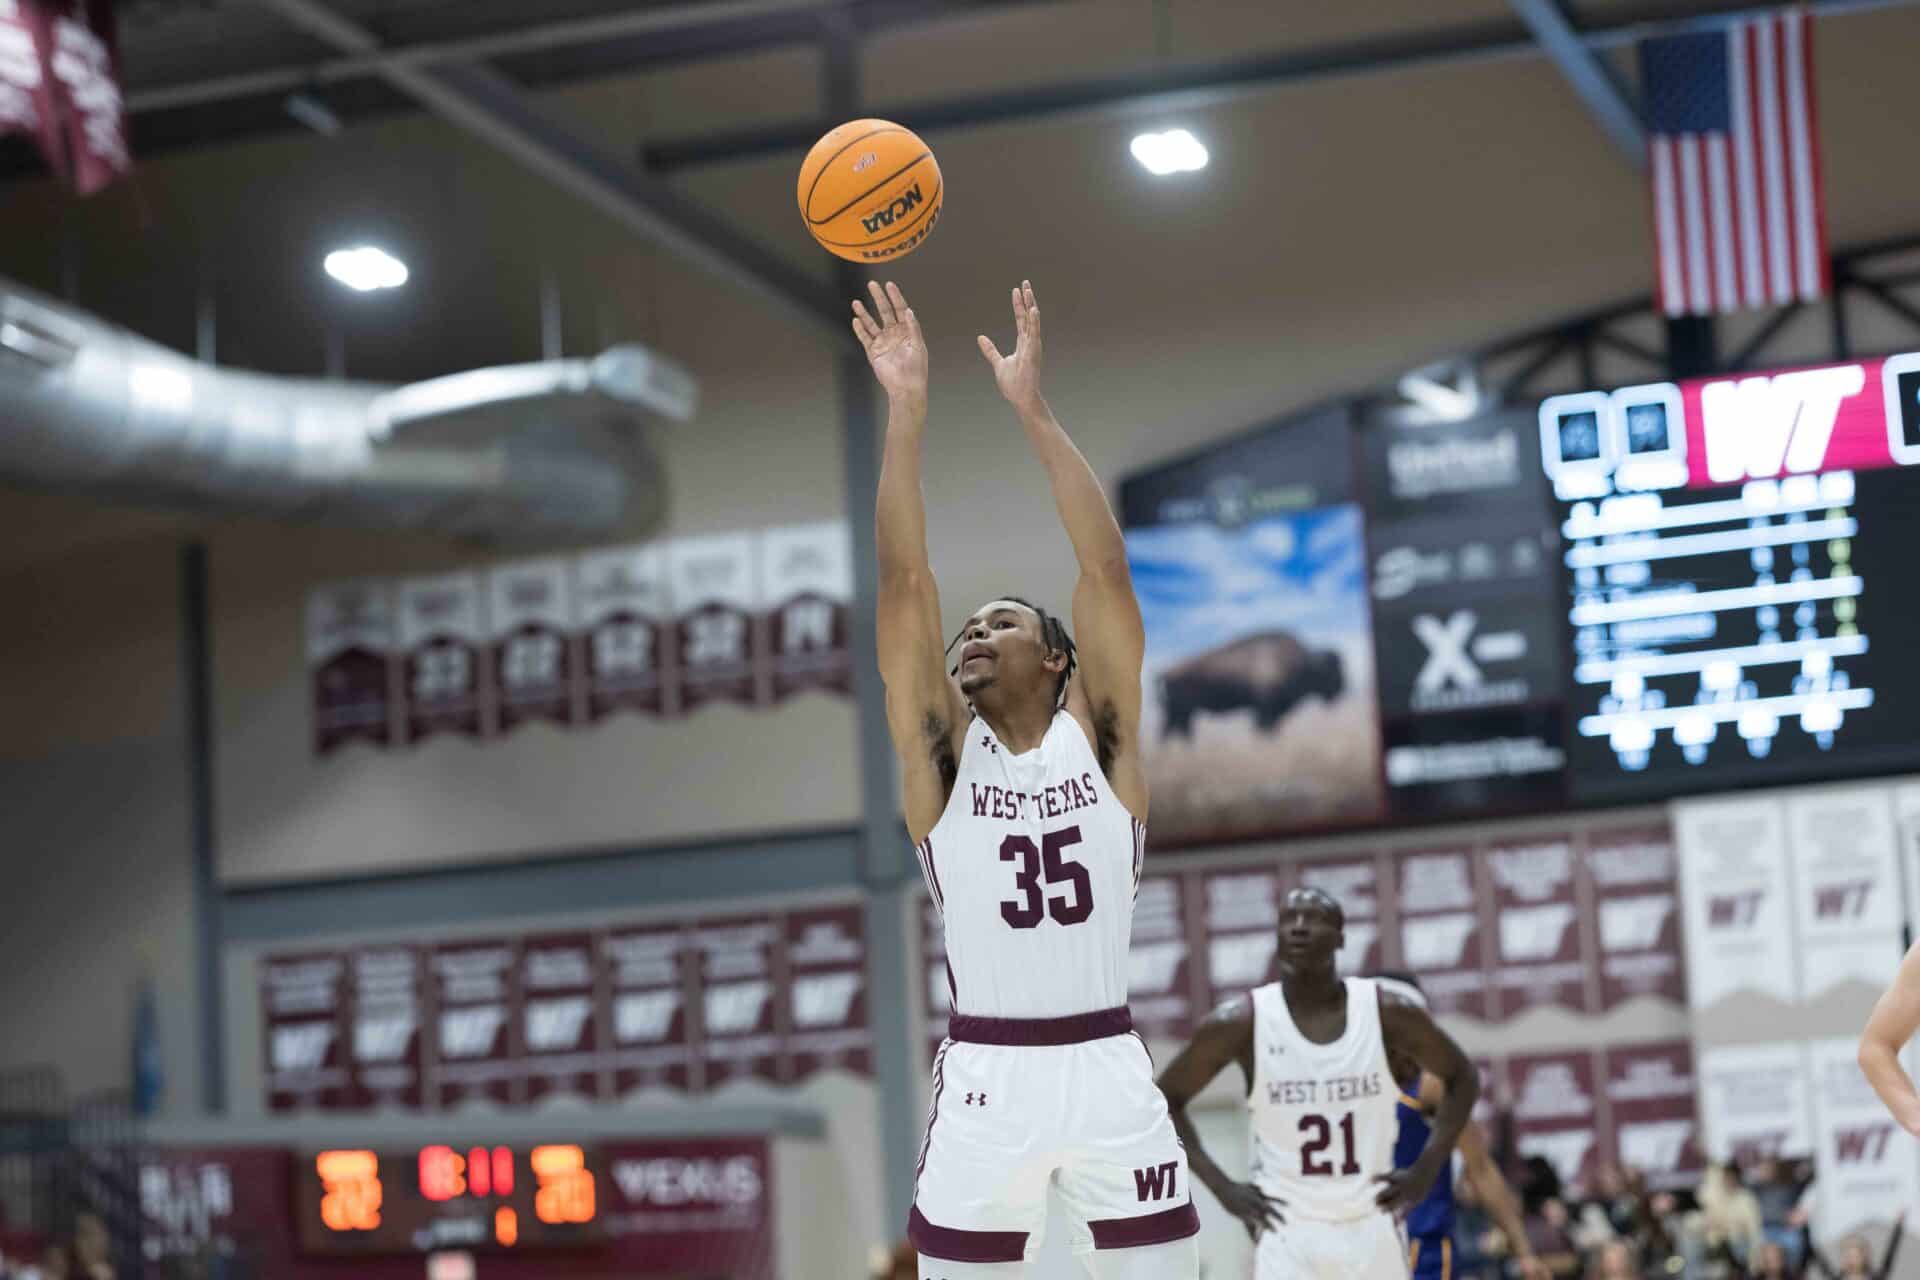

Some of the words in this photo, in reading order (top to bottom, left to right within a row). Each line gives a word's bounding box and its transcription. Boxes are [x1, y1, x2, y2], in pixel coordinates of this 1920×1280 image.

[862, 183, 923, 234] NCAA
[1701, 364, 1866, 483] WT
[971, 782, 1027, 821] WEST
[1031, 772, 1099, 820] TEXAS
[999, 825, 1094, 929] 35
[1268, 1080, 1317, 1104] WEST
[1326, 1074, 1381, 1102] TEXAS
[1298, 1111, 1361, 1176] 21
[1133, 1160, 1178, 1202] WT
